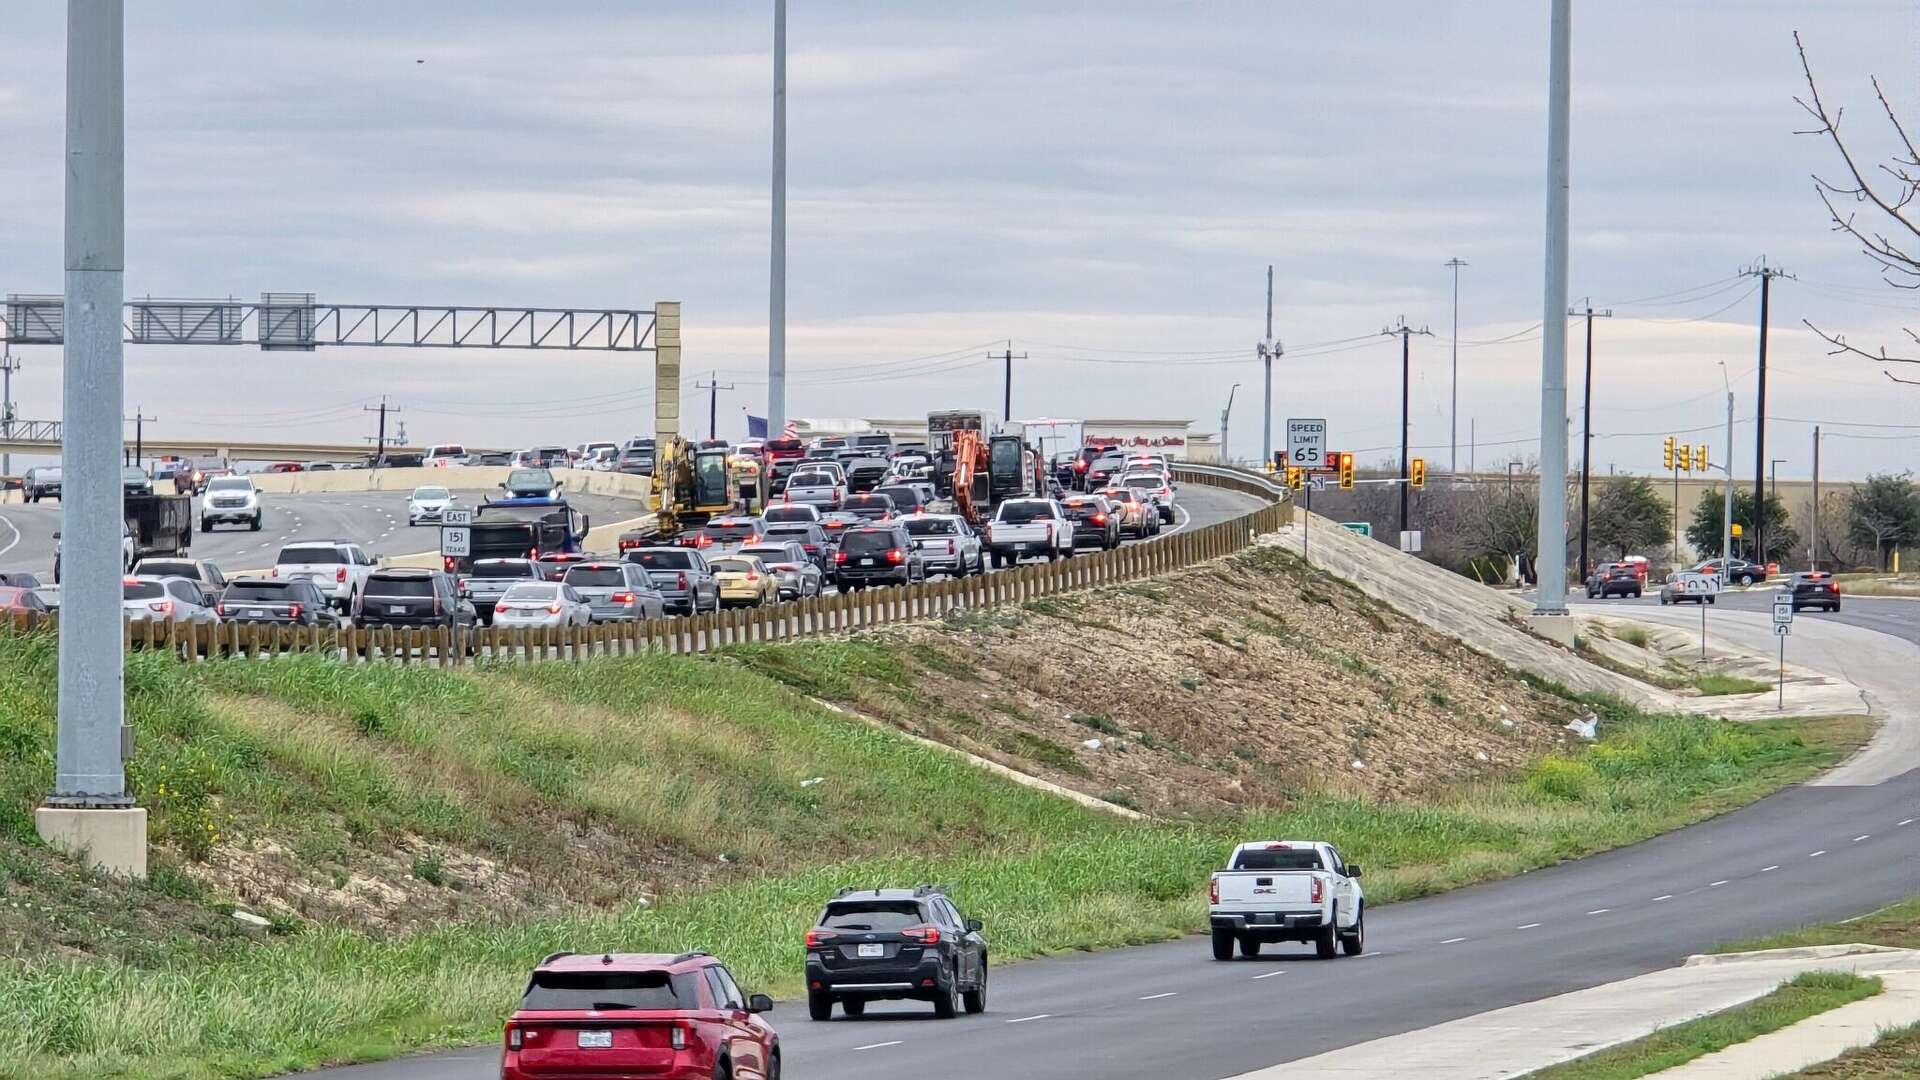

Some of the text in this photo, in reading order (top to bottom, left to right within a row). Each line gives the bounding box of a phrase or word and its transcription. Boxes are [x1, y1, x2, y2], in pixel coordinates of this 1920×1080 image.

[1291, 424, 1323, 432] SPEED
[1294, 435, 1319, 444] LIMIT
[1295, 447, 1318, 462] 65
[446, 511, 466, 522] EAST
[450, 531, 463, 543] 151
